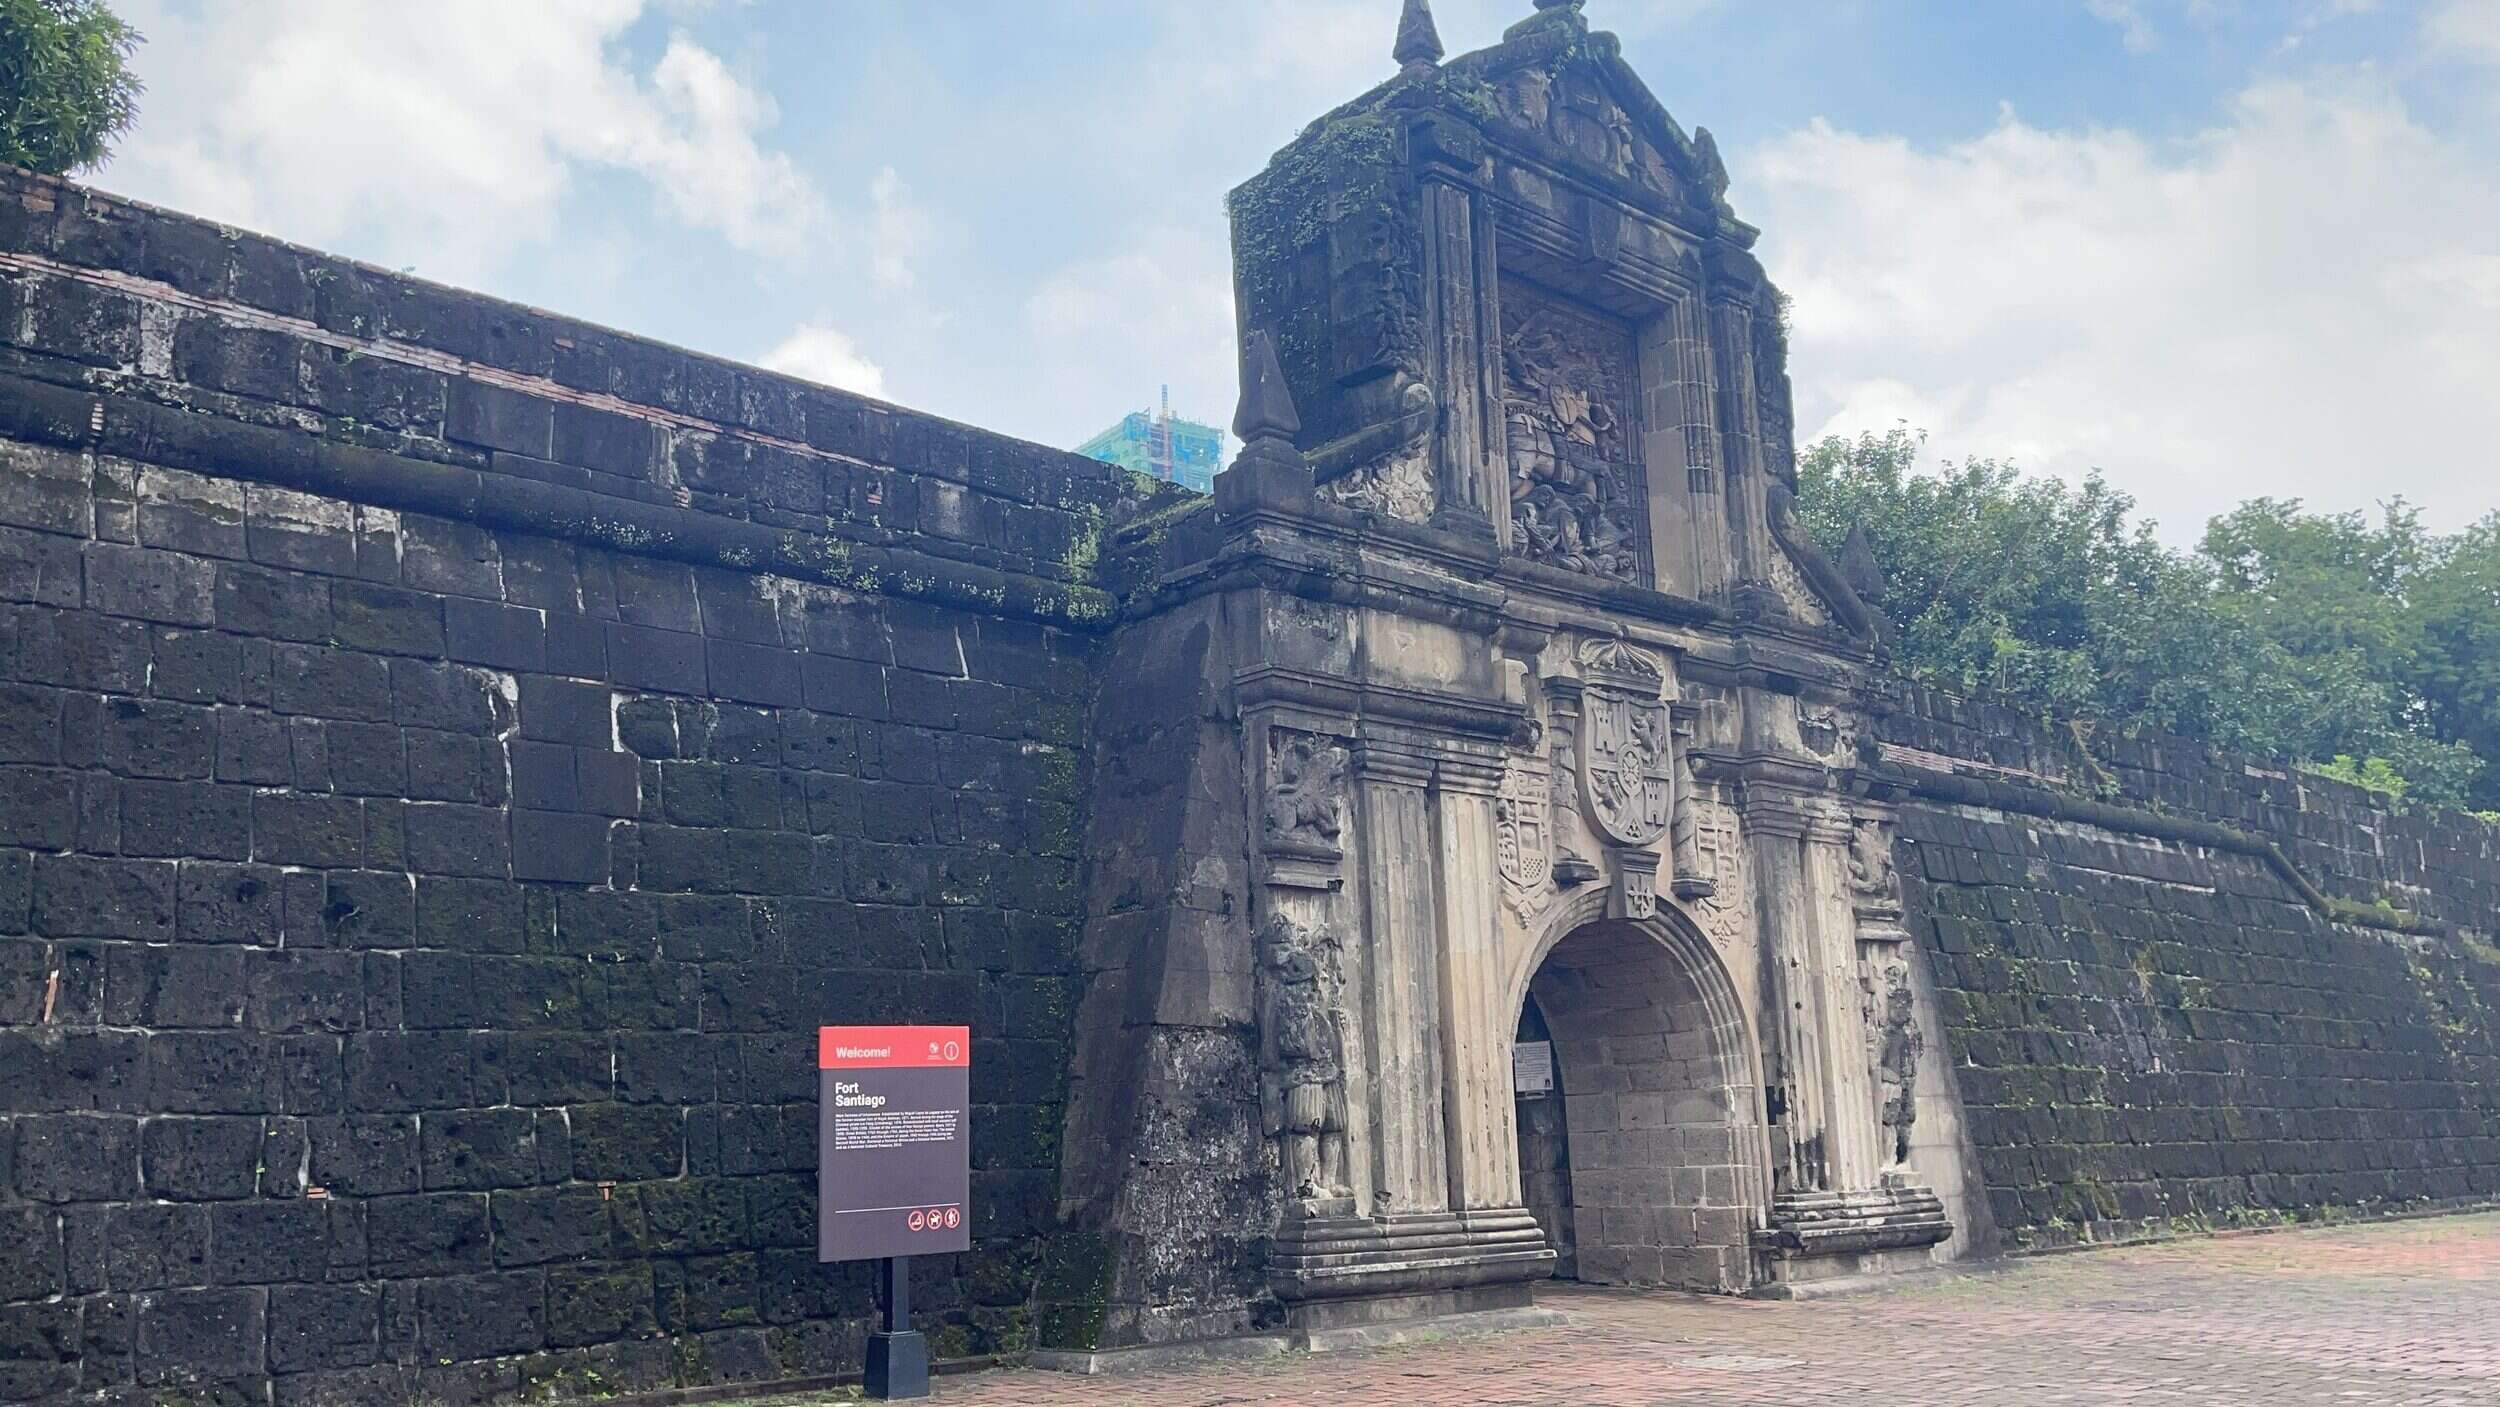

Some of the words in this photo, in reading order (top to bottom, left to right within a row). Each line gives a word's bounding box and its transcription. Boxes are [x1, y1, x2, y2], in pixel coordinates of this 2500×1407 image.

[836, 1047, 891, 1058] Welcome!
[835, 1082, 859, 1094] Fort
[835, 1094, 886, 1108] Santiago
